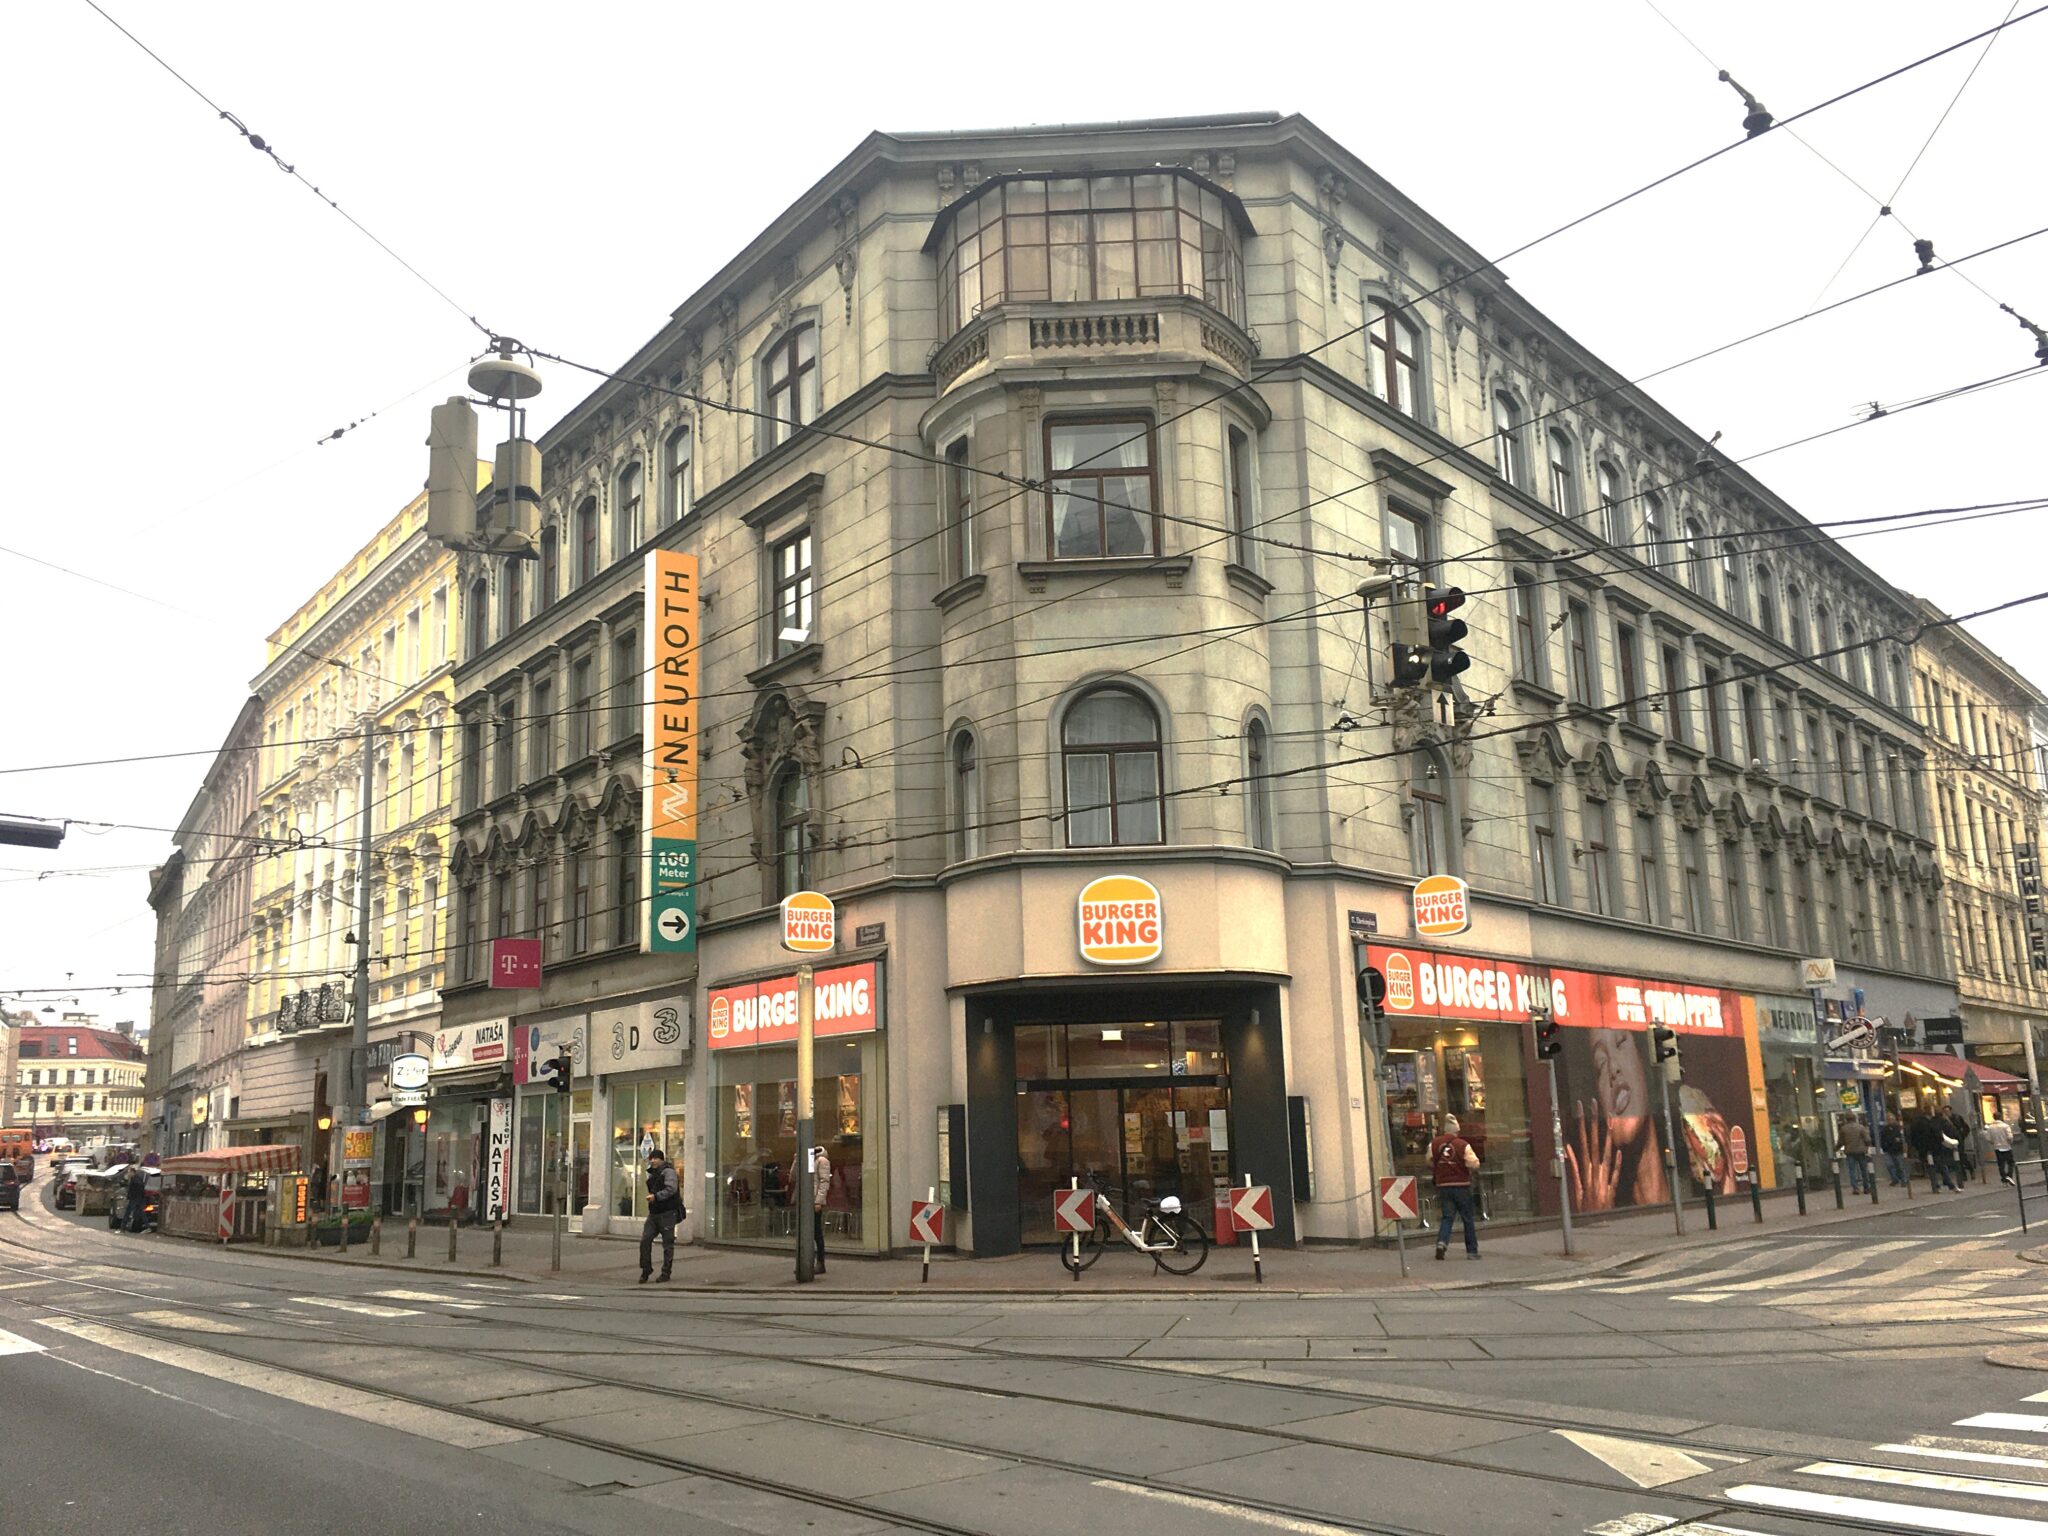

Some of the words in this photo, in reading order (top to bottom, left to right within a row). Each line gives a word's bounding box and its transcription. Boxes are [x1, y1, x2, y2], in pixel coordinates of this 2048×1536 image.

[664, 571, 690, 765] NEUROTH
[659, 852, 690, 867] 100
[659, 868, 690, 878] Meter
[1414, 892, 1463, 908] BURGER
[2018, 842, 2047, 971] JUWELEN
[787, 910, 833, 923] BURGER
[1082, 903, 1157, 921] BURGER
[1416, 904, 1465, 925] KING
[787, 923, 833, 940] KING
[1083, 920, 1158, 945] KING
[1387, 970, 1411, 981] BURGER
[1388, 981, 1412, 997] KING
[1419, 962, 1513, 1012] BURGER
[1515, 973, 1568, 1017] KING
[712, 1009, 728, 1018] BURGER
[733, 990, 800, 1033] BURGE
[815, 978, 869, 1021] KING
[653, 1007, 681, 1044] 3
[712, 1017, 728, 1029] KING
[1770, 1009, 1814, 1032] NEUROTH
[475, 1022, 503, 1045] NATAŠA
[612, 1021, 625, 1060] 3
[630, 1026, 639, 1050] D
